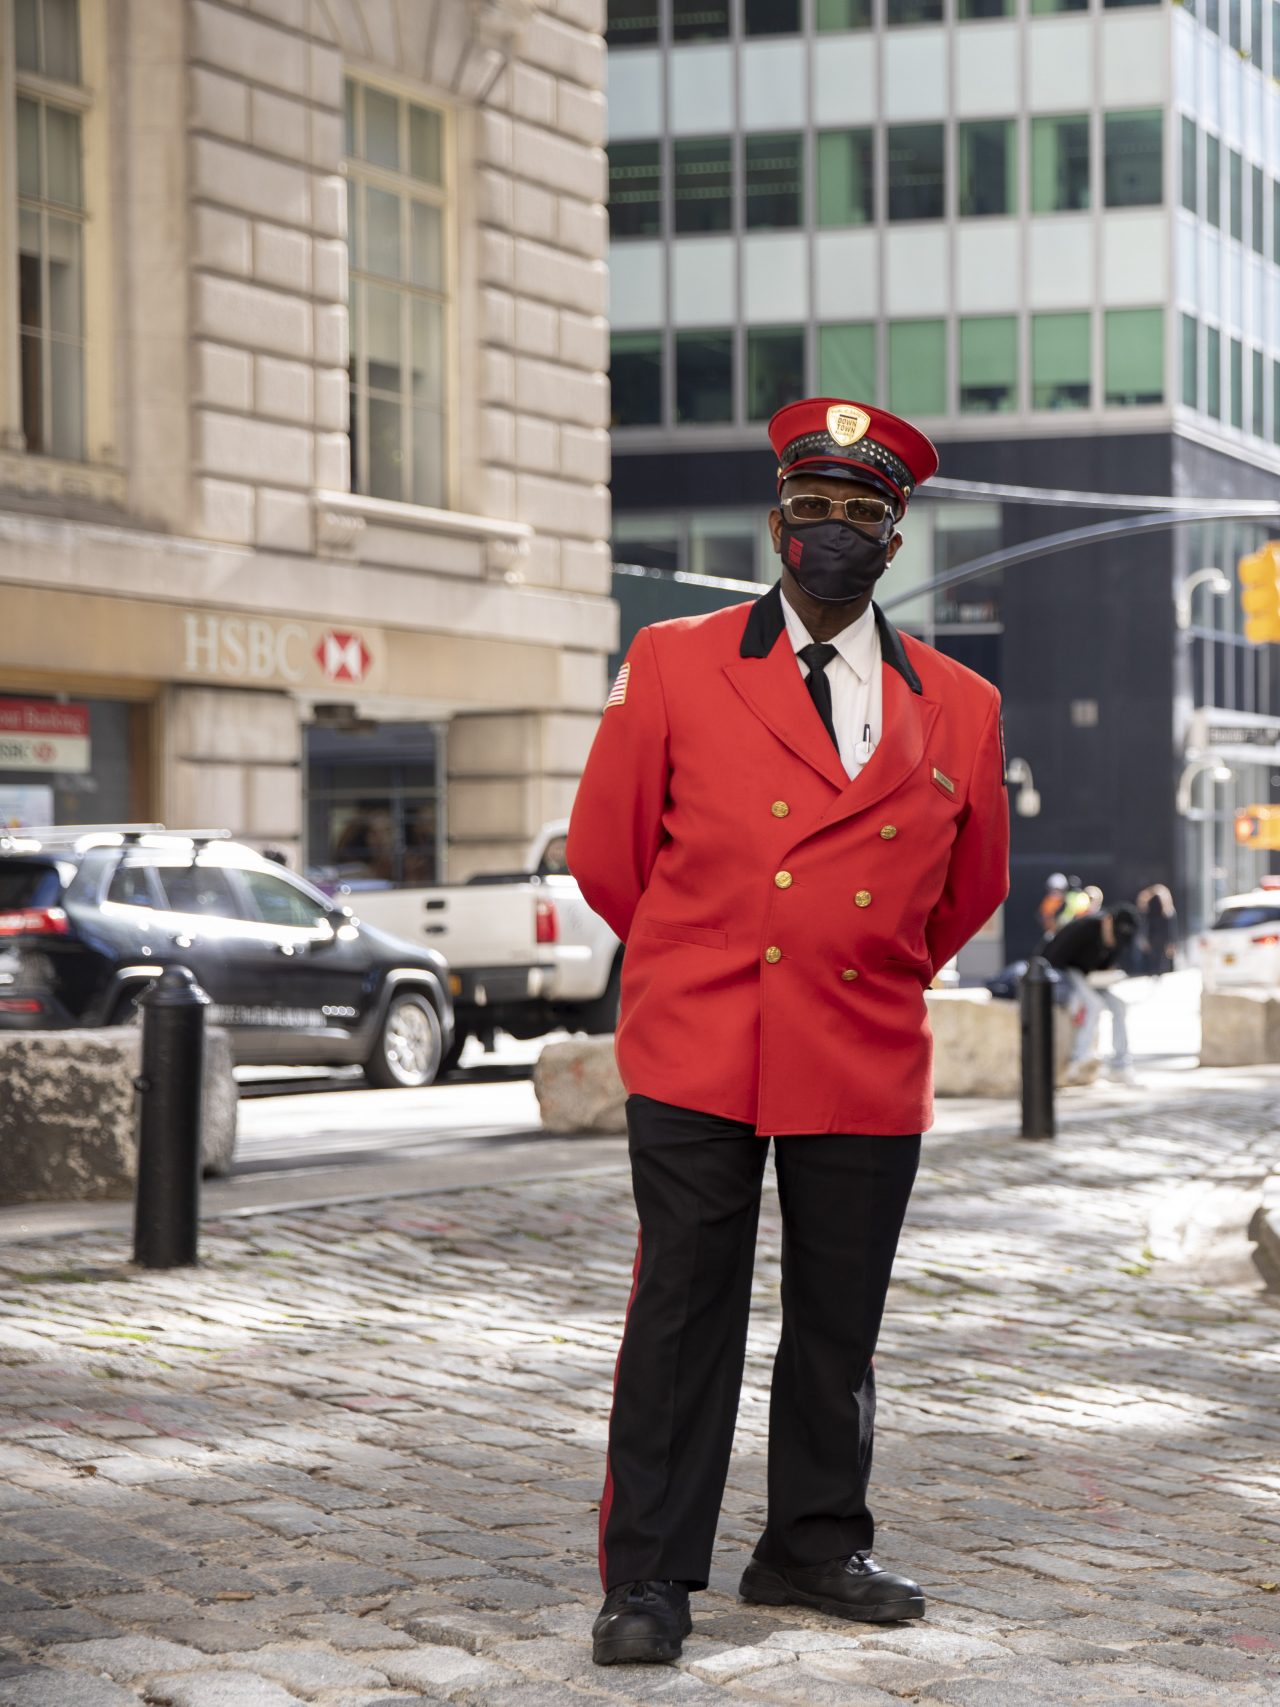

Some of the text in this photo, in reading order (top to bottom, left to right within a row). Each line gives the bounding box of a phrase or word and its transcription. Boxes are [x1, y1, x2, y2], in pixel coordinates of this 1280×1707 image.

[837, 417, 857, 428] DOWN
[837, 423, 856, 434] TOWN
[183, 612, 308, 682] HSBC
